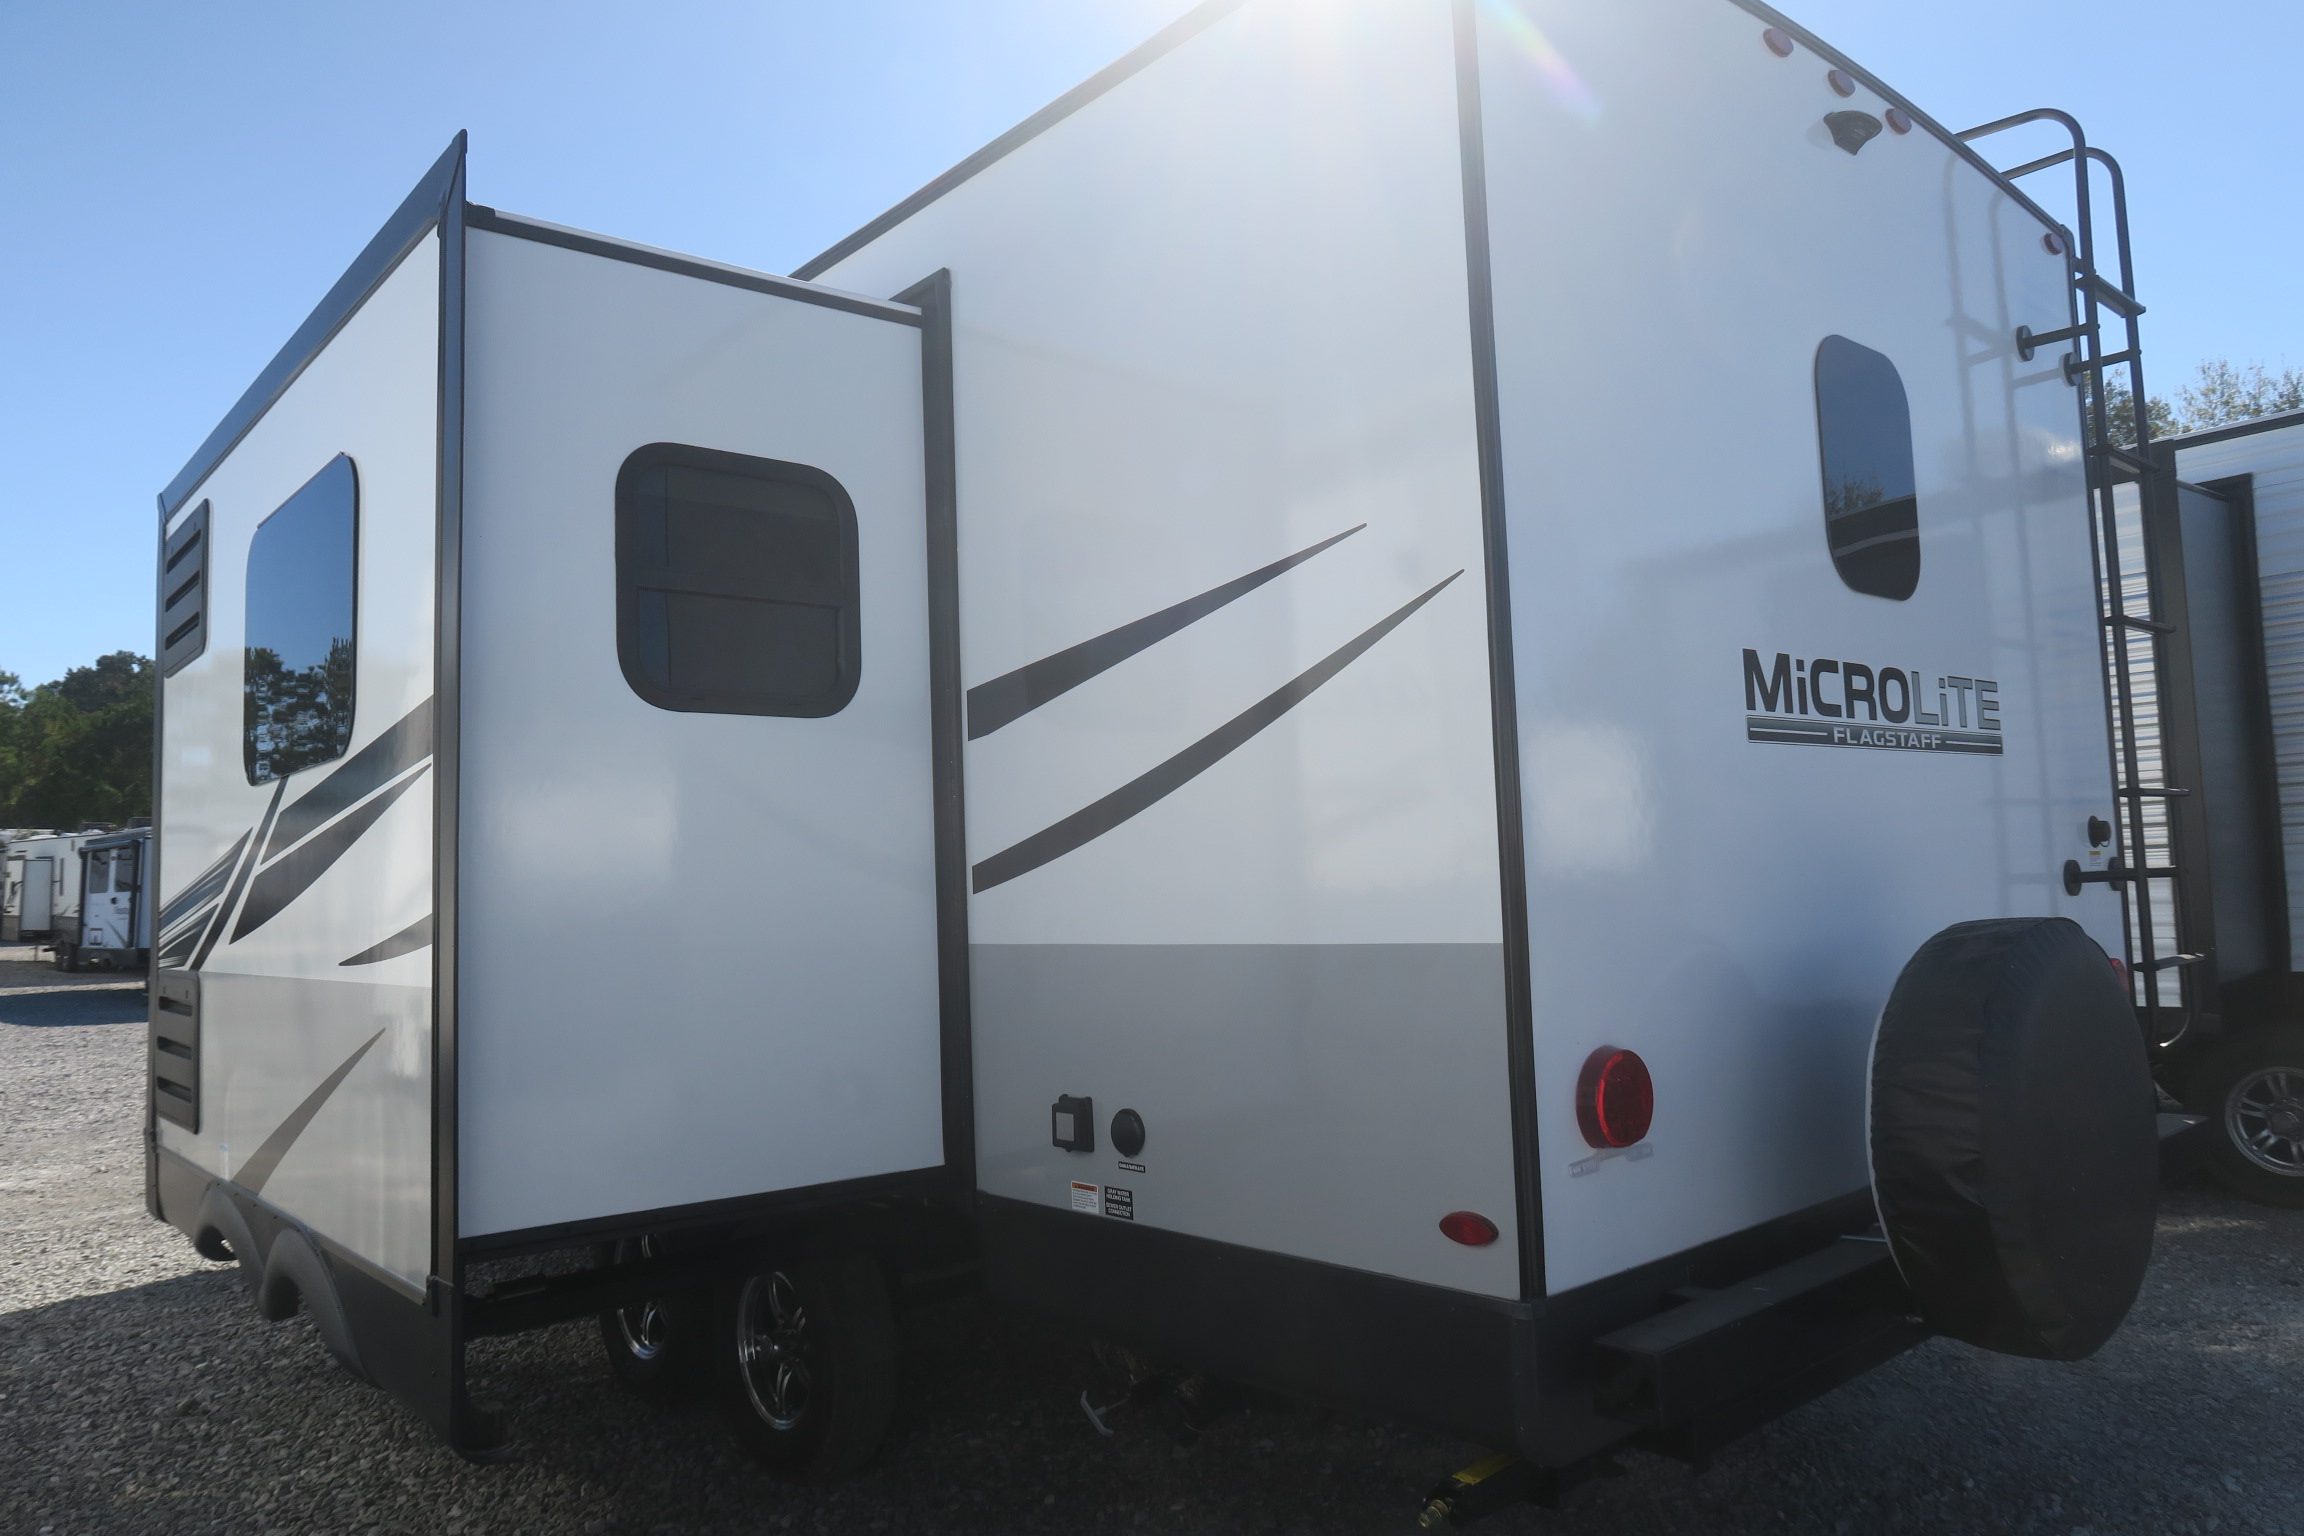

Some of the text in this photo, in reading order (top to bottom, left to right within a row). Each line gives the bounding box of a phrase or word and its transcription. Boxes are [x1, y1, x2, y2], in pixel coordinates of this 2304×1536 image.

[1833, 727, 1942, 749] FLAGSTAFF
[1108, 1208, 1130, 1217] CONNECTION
[1119, 1204, 1132, 1212] OUTLET
